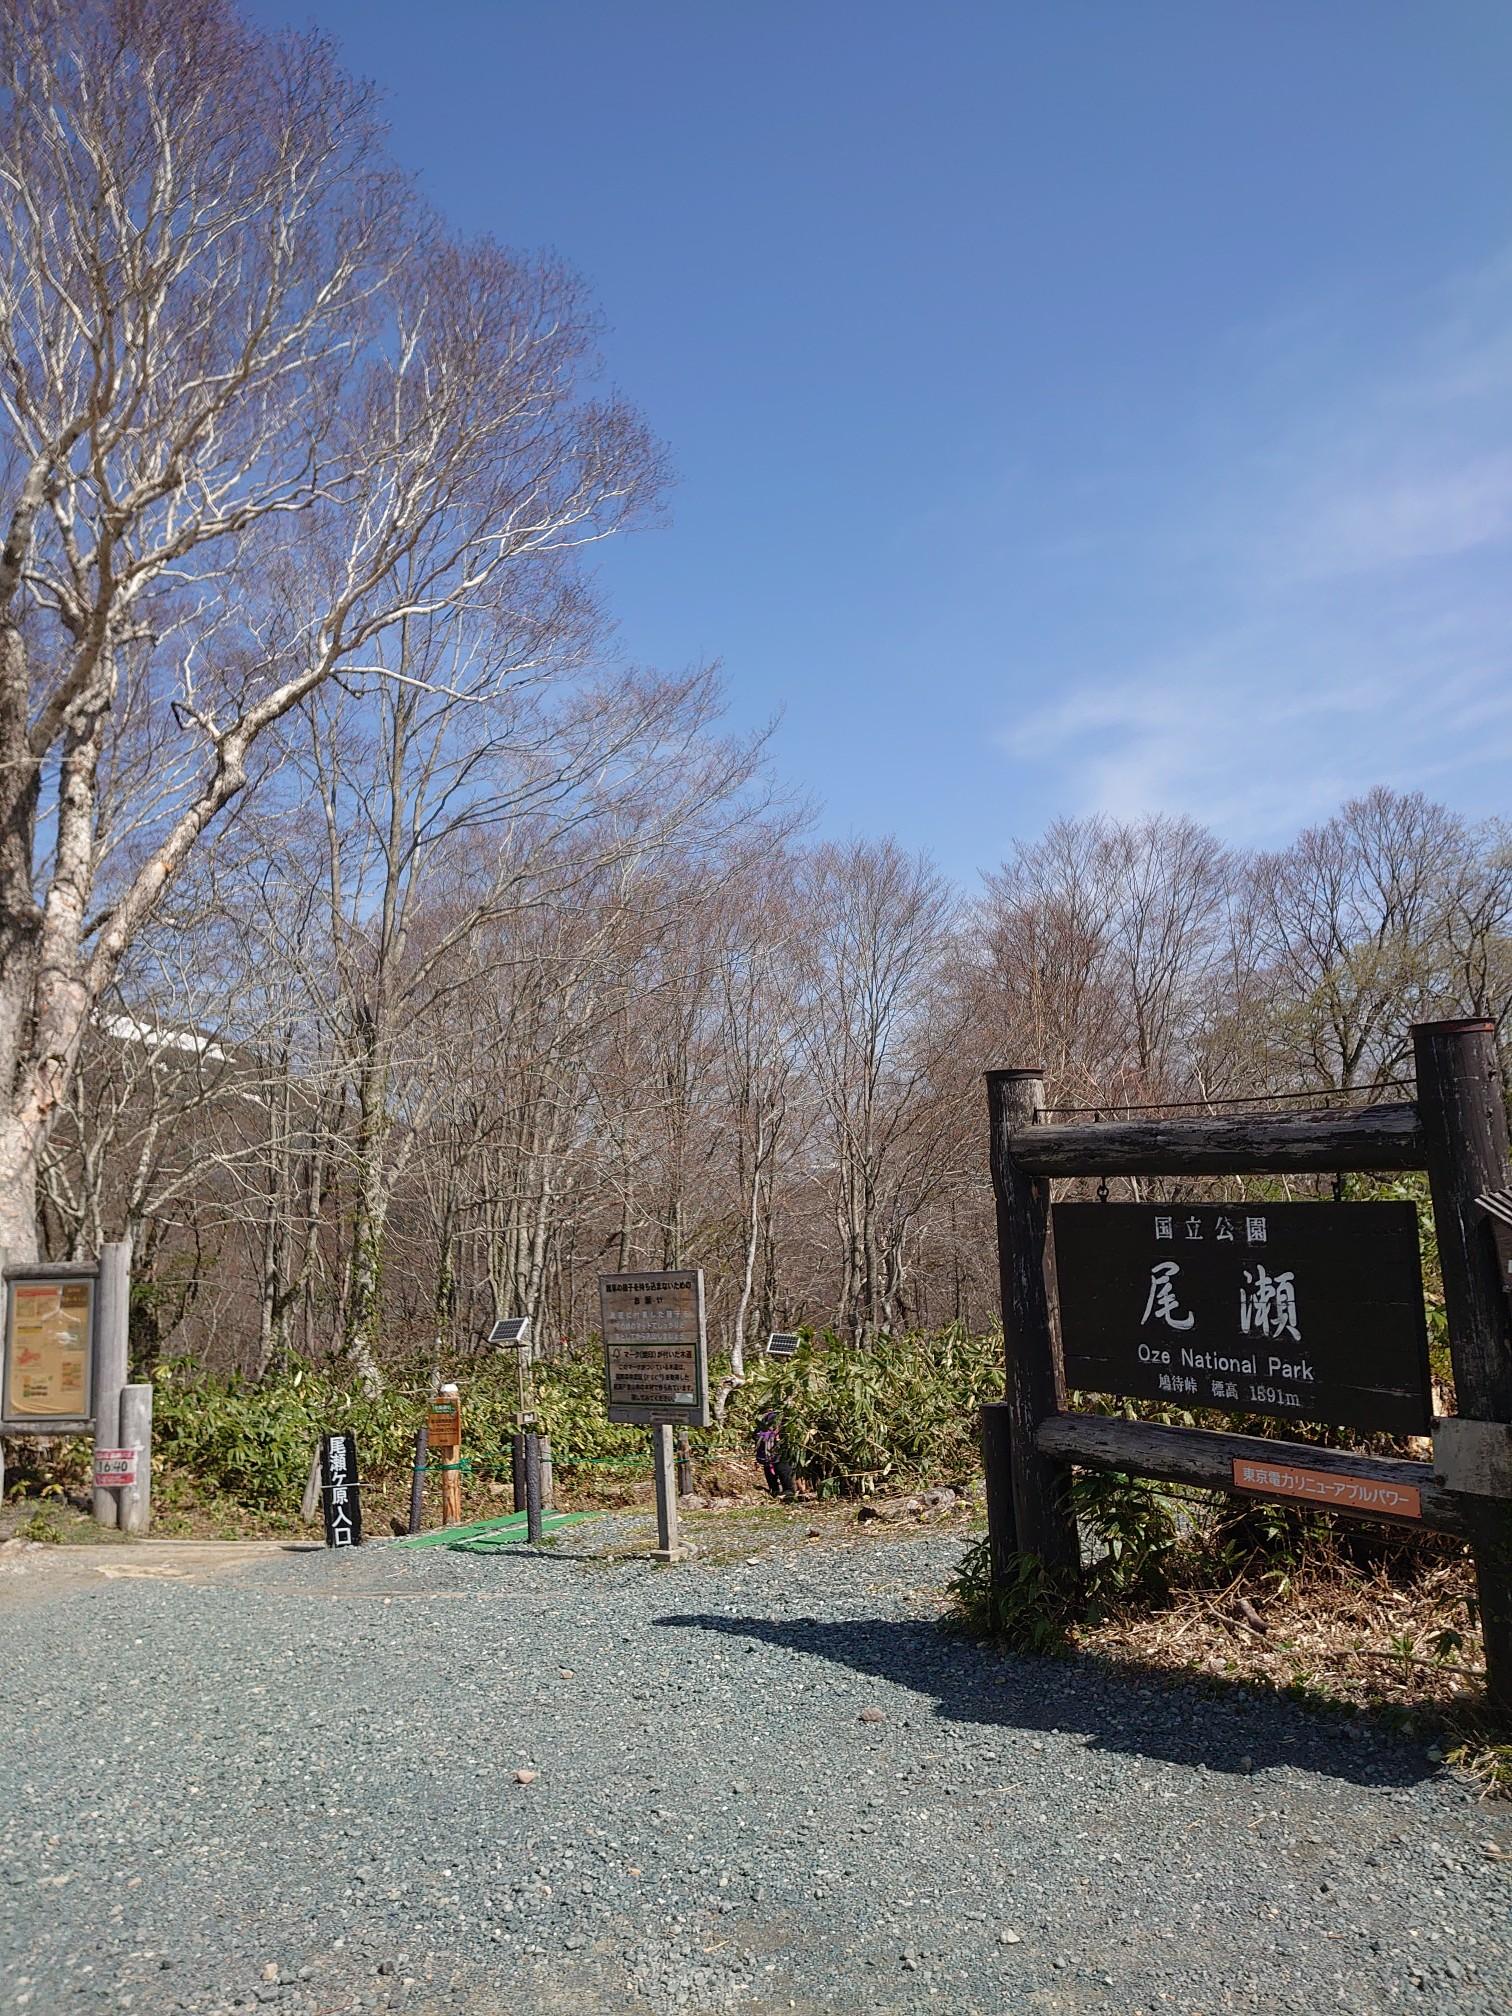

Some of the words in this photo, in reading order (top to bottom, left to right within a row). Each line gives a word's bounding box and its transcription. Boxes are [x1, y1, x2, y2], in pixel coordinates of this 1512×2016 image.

[1154, 1215, 1268, 1243] 国立公園
[1139, 1260, 1302, 1342] 尾瀬
[1137, 1342, 1171, 1365] Oze
[1181, 1347, 1257, 1374] National
[1268, 1356, 1315, 1381] Park
[1158, 1373, 1198, 1394] 鳩待峠
[1211, 1379, 1239, 1400] 標高
[1249, 1384, 1301, 1407] 1591m
[1242, 1466, 1410, 1507] 東京電力リニューアブルパワー
